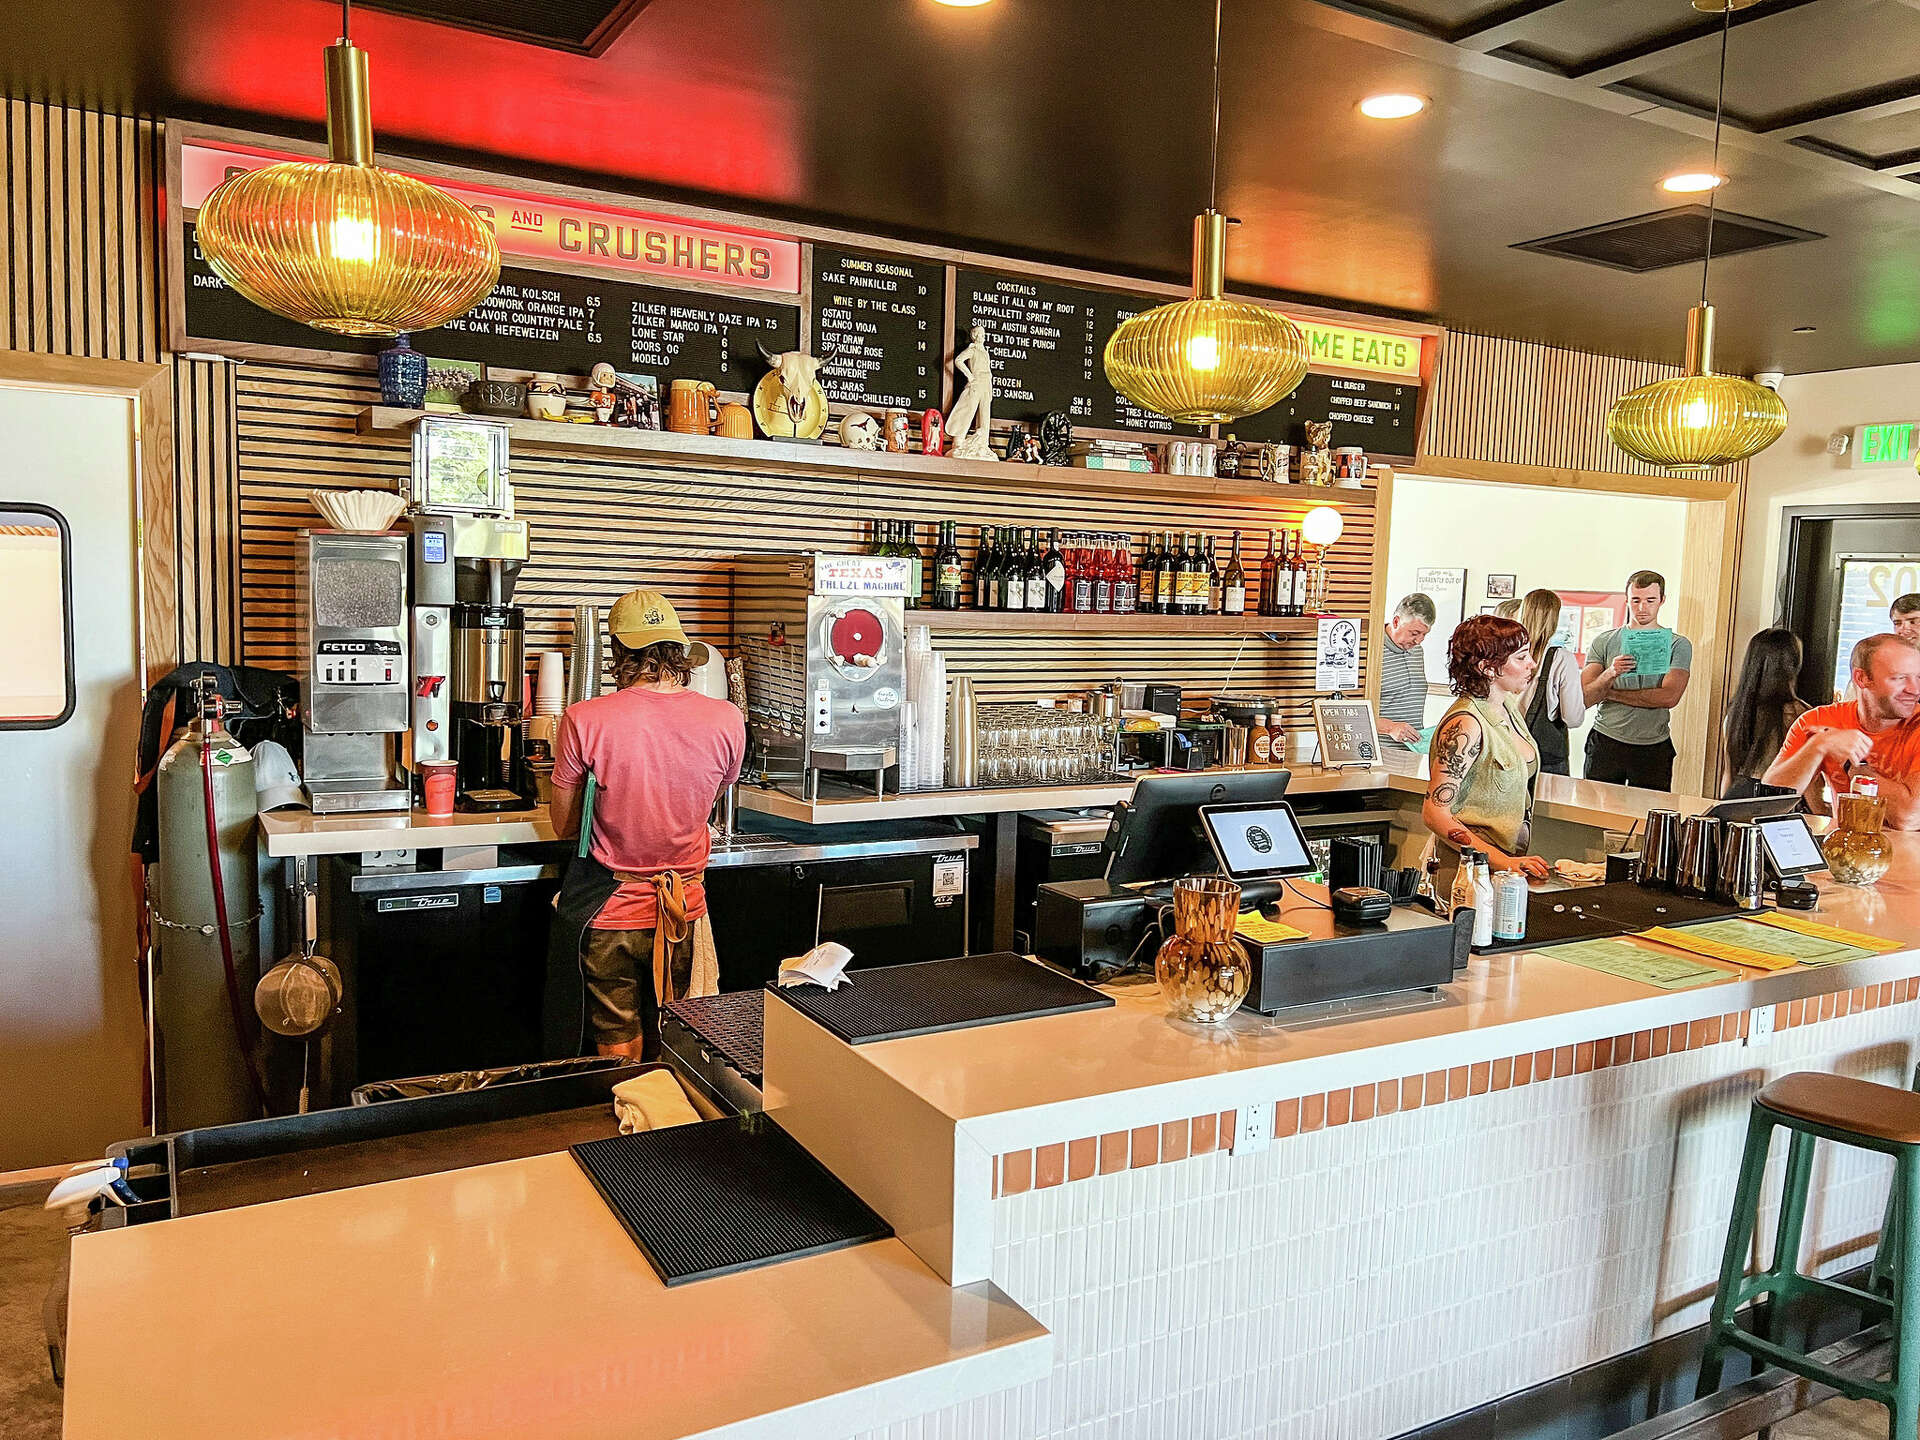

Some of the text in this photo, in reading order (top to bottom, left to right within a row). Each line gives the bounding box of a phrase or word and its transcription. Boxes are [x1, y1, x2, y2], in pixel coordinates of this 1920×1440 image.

[512, 210, 543, 228] AND
[558, 217, 771, 280] CRUSHERS
[840, 259, 914, 278] SUMMER SEASONAL
[822, 272, 926, 295] SAKE PAINKILLER 10
[996, 281, 1036, 296] COCKTAILS
[492, 284, 600, 307] CARL KOLSCH 6.5
[528, 302, 565, 316] ORANGE
[569, 307, 584, 318] IPA
[588, 309, 595, 319] 7
[833, 295, 916, 315] WINE BY THE GLASS
[973, 292, 1094, 317] BLAME IT ALL ON MY ROOT 12
[468, 308, 595, 332] FLAVOR COUNTRY PALE 7
[632, 302, 777, 329] ZILKER HEAVENLY DAZE IPA 7.5
[822, 308, 851, 320] OSTATU
[972, 305, 1094, 330] CAPPALLETTI SPRITZ 12
[1117, 310, 1137, 320] RICK
[444, 319, 602, 343] LIVE OAK HEFEWEIZEN 6.5
[632, 314, 728, 335] ZILKER MARCO IPA 7
[822, 318, 852, 330] BLANCO
[918, 320, 926, 330] 12
[972, 318, 1093, 342] SOUTH AUSTIN SANGRIA 12
[632, 327, 728, 348] LONE STAR 6
[822, 332, 864, 345] LOST DRAW
[1005, 335, 1015, 344] TO
[1016, 337, 1030, 347] THE
[1032, 339, 1055, 350] PUNCH
[1084, 346, 1093, 355] 13
[632, 340, 728, 360] COORS OG 6
[864, 347, 884, 358] ROSE
[918, 341, 926, 351] 14
[985, 346, 1092, 367] T-CHELADA 10
[1352, 336, 1406, 368] EATS
[632, 353, 728, 372] MODELO 6
[857, 360, 881, 371] CHRIS
[918, 366, 926, 376] 13
[990, 360, 1092, 380] EPE 12
[822, 366, 867, 379] MOURVEDRE
[822, 379, 865, 392] LAS JARAS
[992, 376, 1022, 388] FROZEN
[1344, 381, 1365, 391] BURGER
[896, 396, 911, 406] RED
[918, 390, 926, 399] 15
[992, 388, 1034, 401] ED SANGRIA
[1073, 397, 1091, 406] SM 8
[1070, 406, 1092, 415] REG 12
[1330, 396, 1353, 406] CHOPPED
[1353, 398, 1367, 407] BEEF
[1368, 400, 1392, 410] SANDWICH
[1125, 408, 1141, 418] TRES
[1329, 412, 1352, 421] CHOPPED
[1353, 415, 1374, 424] CHEESE
[1126, 418, 1147, 427] HONEY
[1149, 420, 1172, 430] CITRUS
[1862, 422, 1914, 464] EXIT
[828, 567, 883, 579] TEXAS
[864, 581, 906, 591] MACHINE
[323, 643, 365, 651] FETCO
[932, 854, 964, 863] True
[412, 898, 454, 907] True
